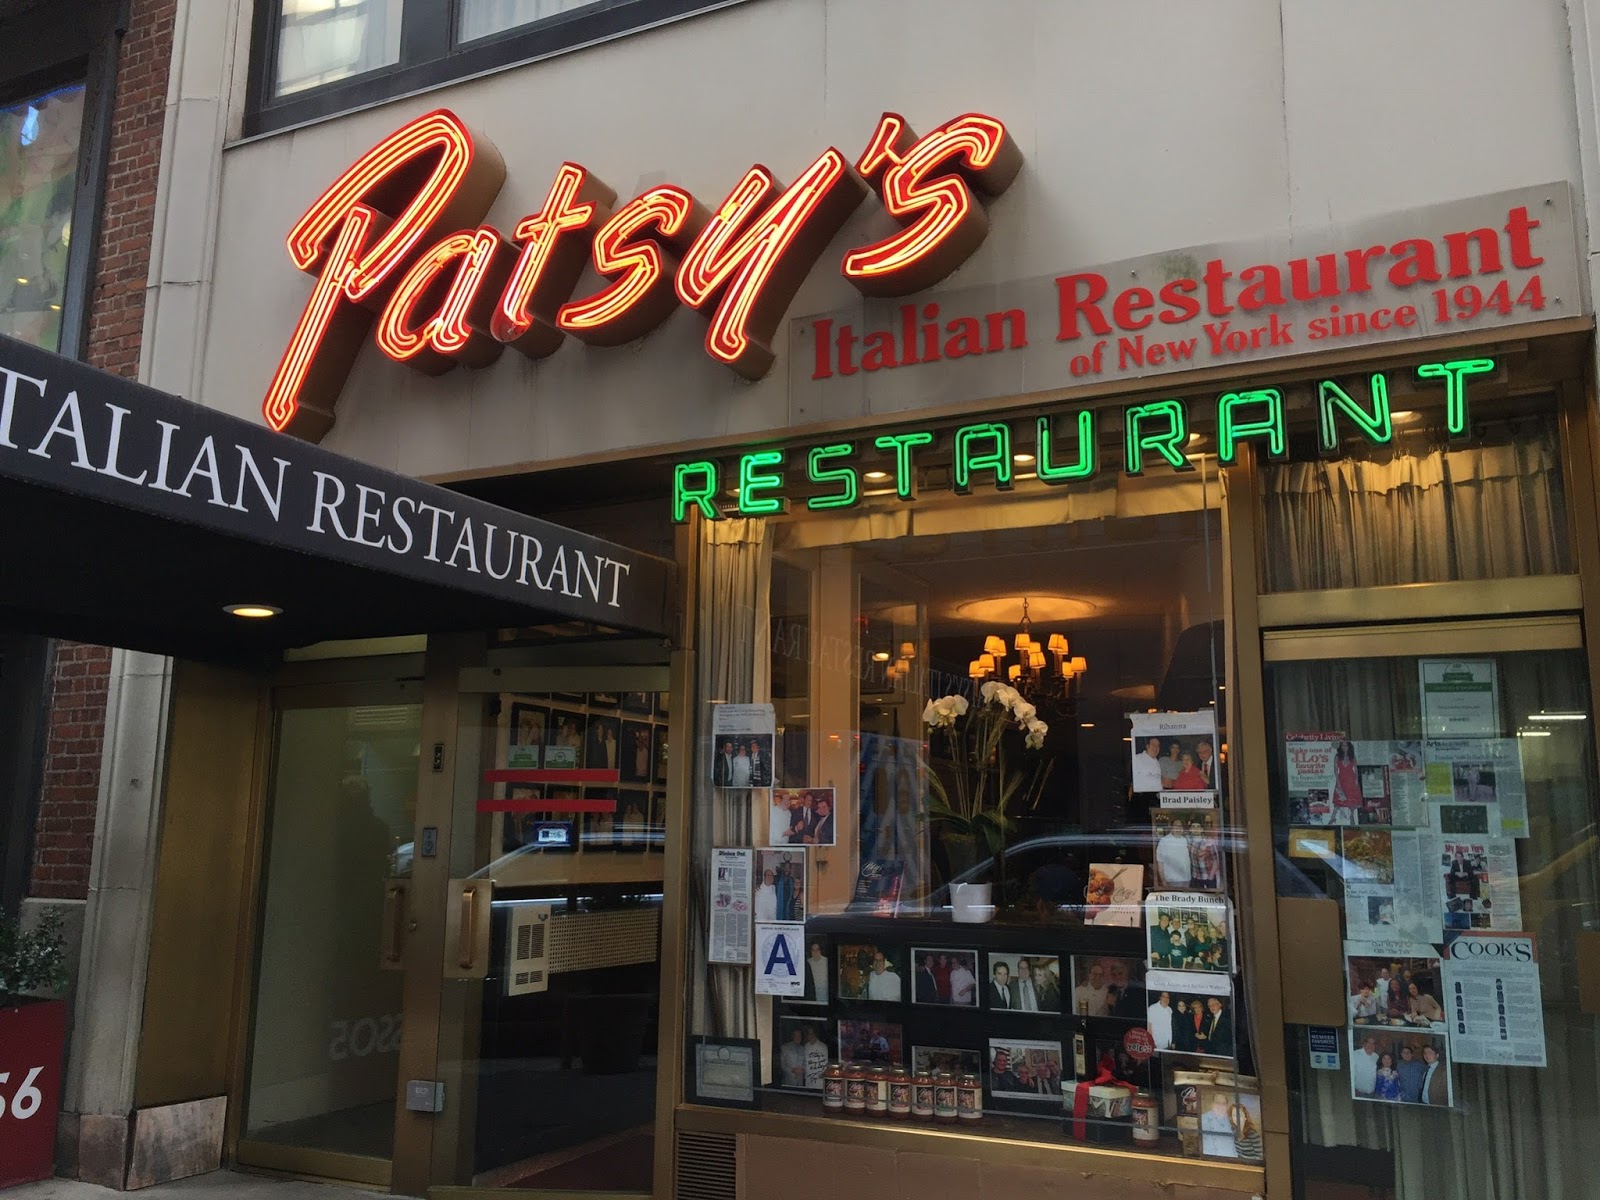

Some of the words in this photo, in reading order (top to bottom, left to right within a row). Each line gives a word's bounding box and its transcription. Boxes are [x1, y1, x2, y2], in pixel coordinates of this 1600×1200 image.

[262, 107, 1005, 432] Patsy's
[811, 302, 1027, 380] Italian
[1055, 206, 1544, 341] Restaurant
[1070, 340, 1104, 377] of
[1117, 334, 1197, 370] New
[1203, 311, 1294, 356] York
[1307, 300, 1416, 341] since
[1433, 275, 1547, 324] 1944
[672, 358, 1496, 522] RESTAURANT
[307, 470, 630, 608] RESTAURANT
[1162, 796, 1182, 804] Brad
[1183, 796, 1213, 805] Paisley
[1155, 894, 1170, 902] The
[1171, 894, 1197, 903] Brady
[1198, 896, 1225, 904] Bunch
[764, 934, 797, 976] A
[1451, 941, 1531, 963] COOK'S
